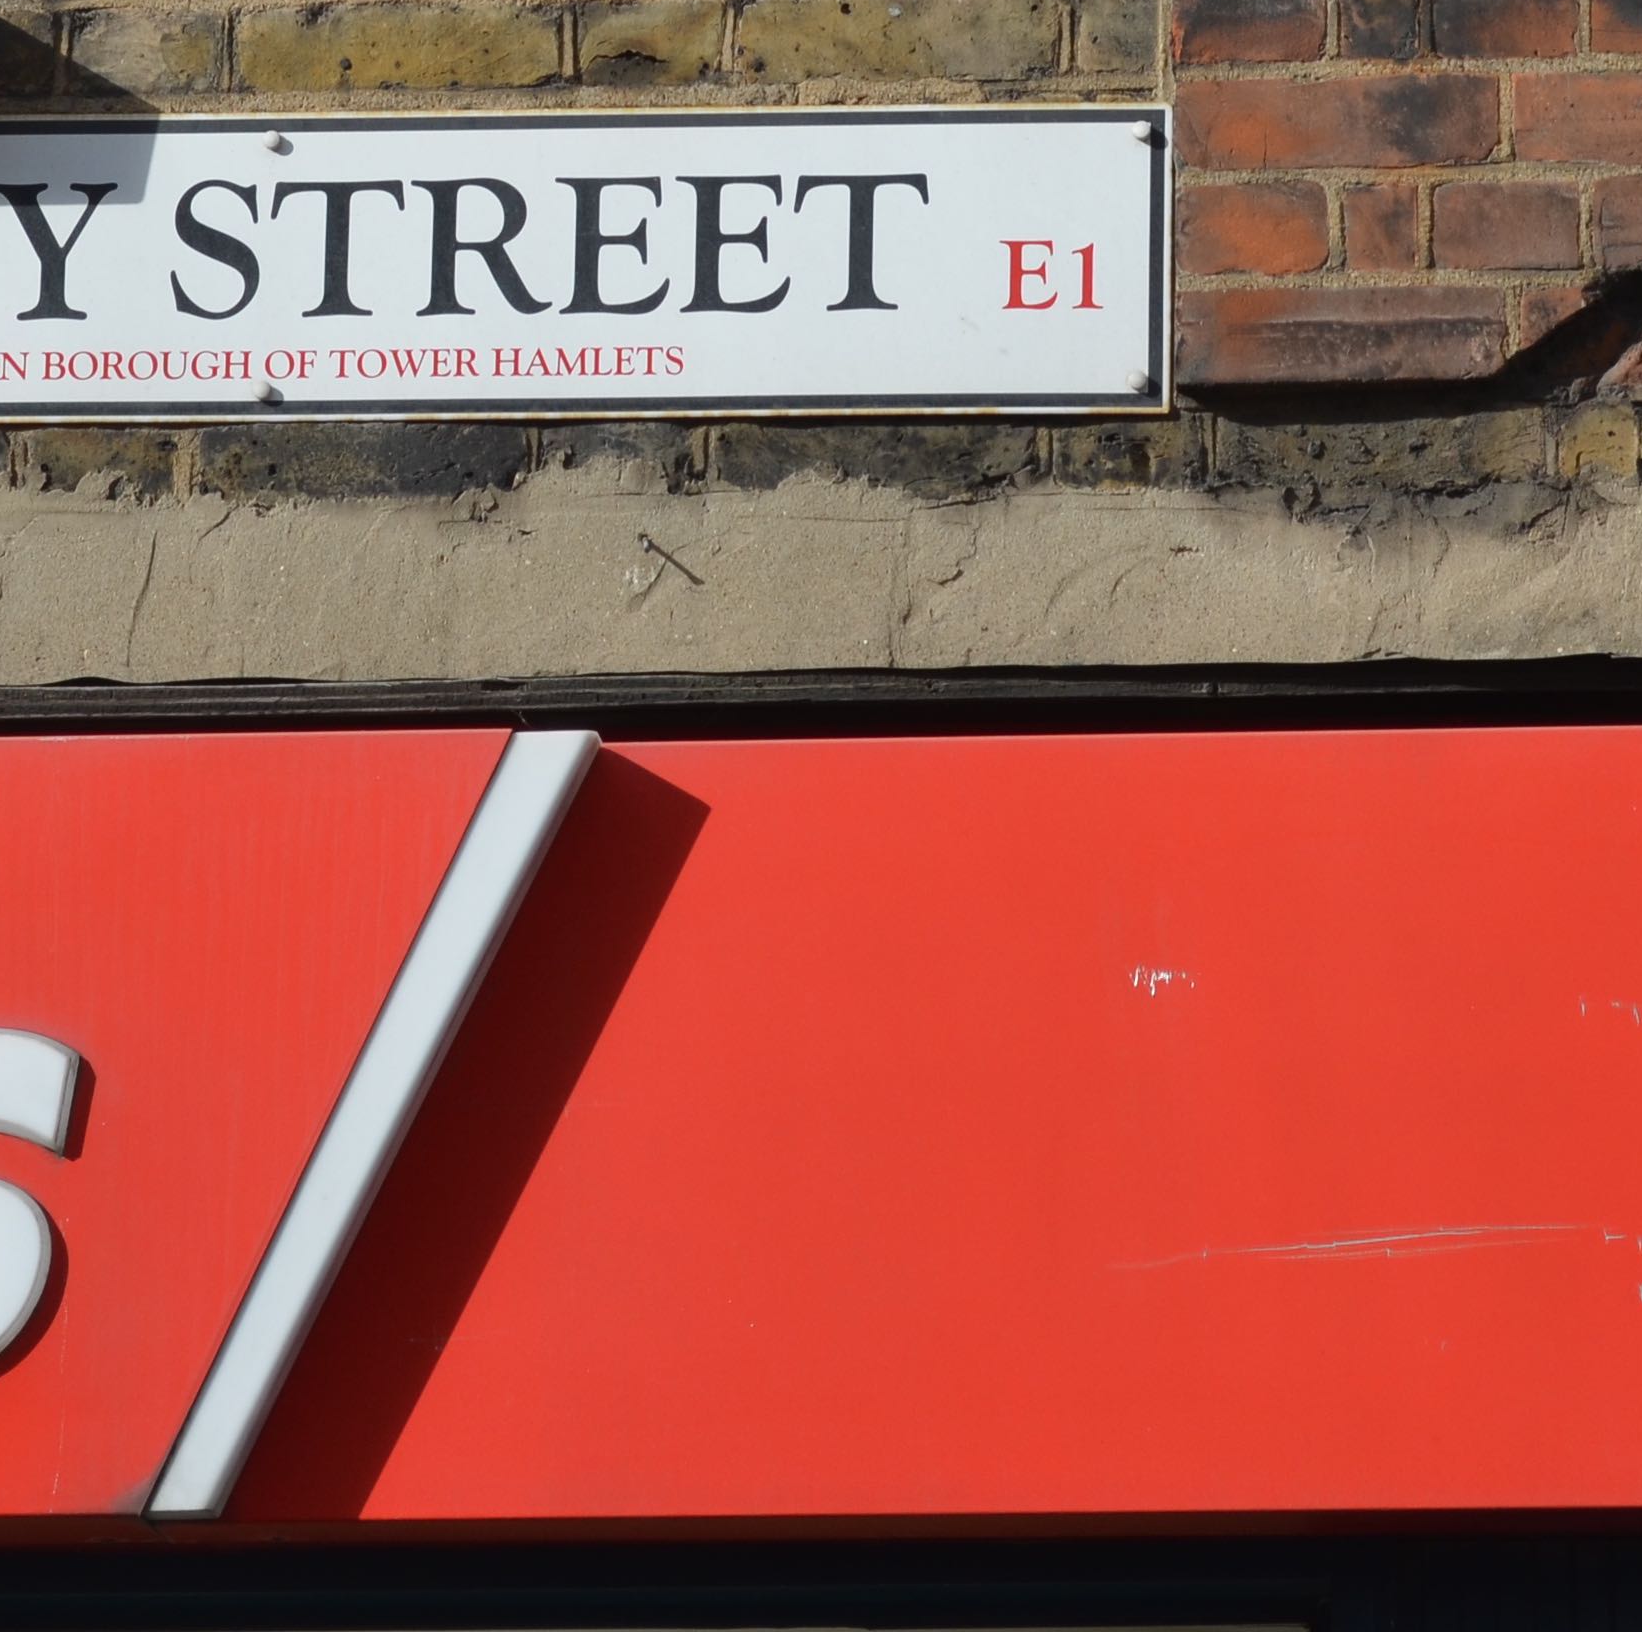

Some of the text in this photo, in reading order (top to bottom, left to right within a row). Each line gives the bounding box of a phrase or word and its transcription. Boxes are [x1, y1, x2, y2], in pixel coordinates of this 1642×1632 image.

[170, 173, 930, 321] STREET
[1000, 239, 1105, 311] E1
[41, 349, 253, 382] BOROUGH
[263, 348, 319, 381] OF
[328, 347, 480, 379] TOWER
[492, 344, 686, 378] HAMLETS
